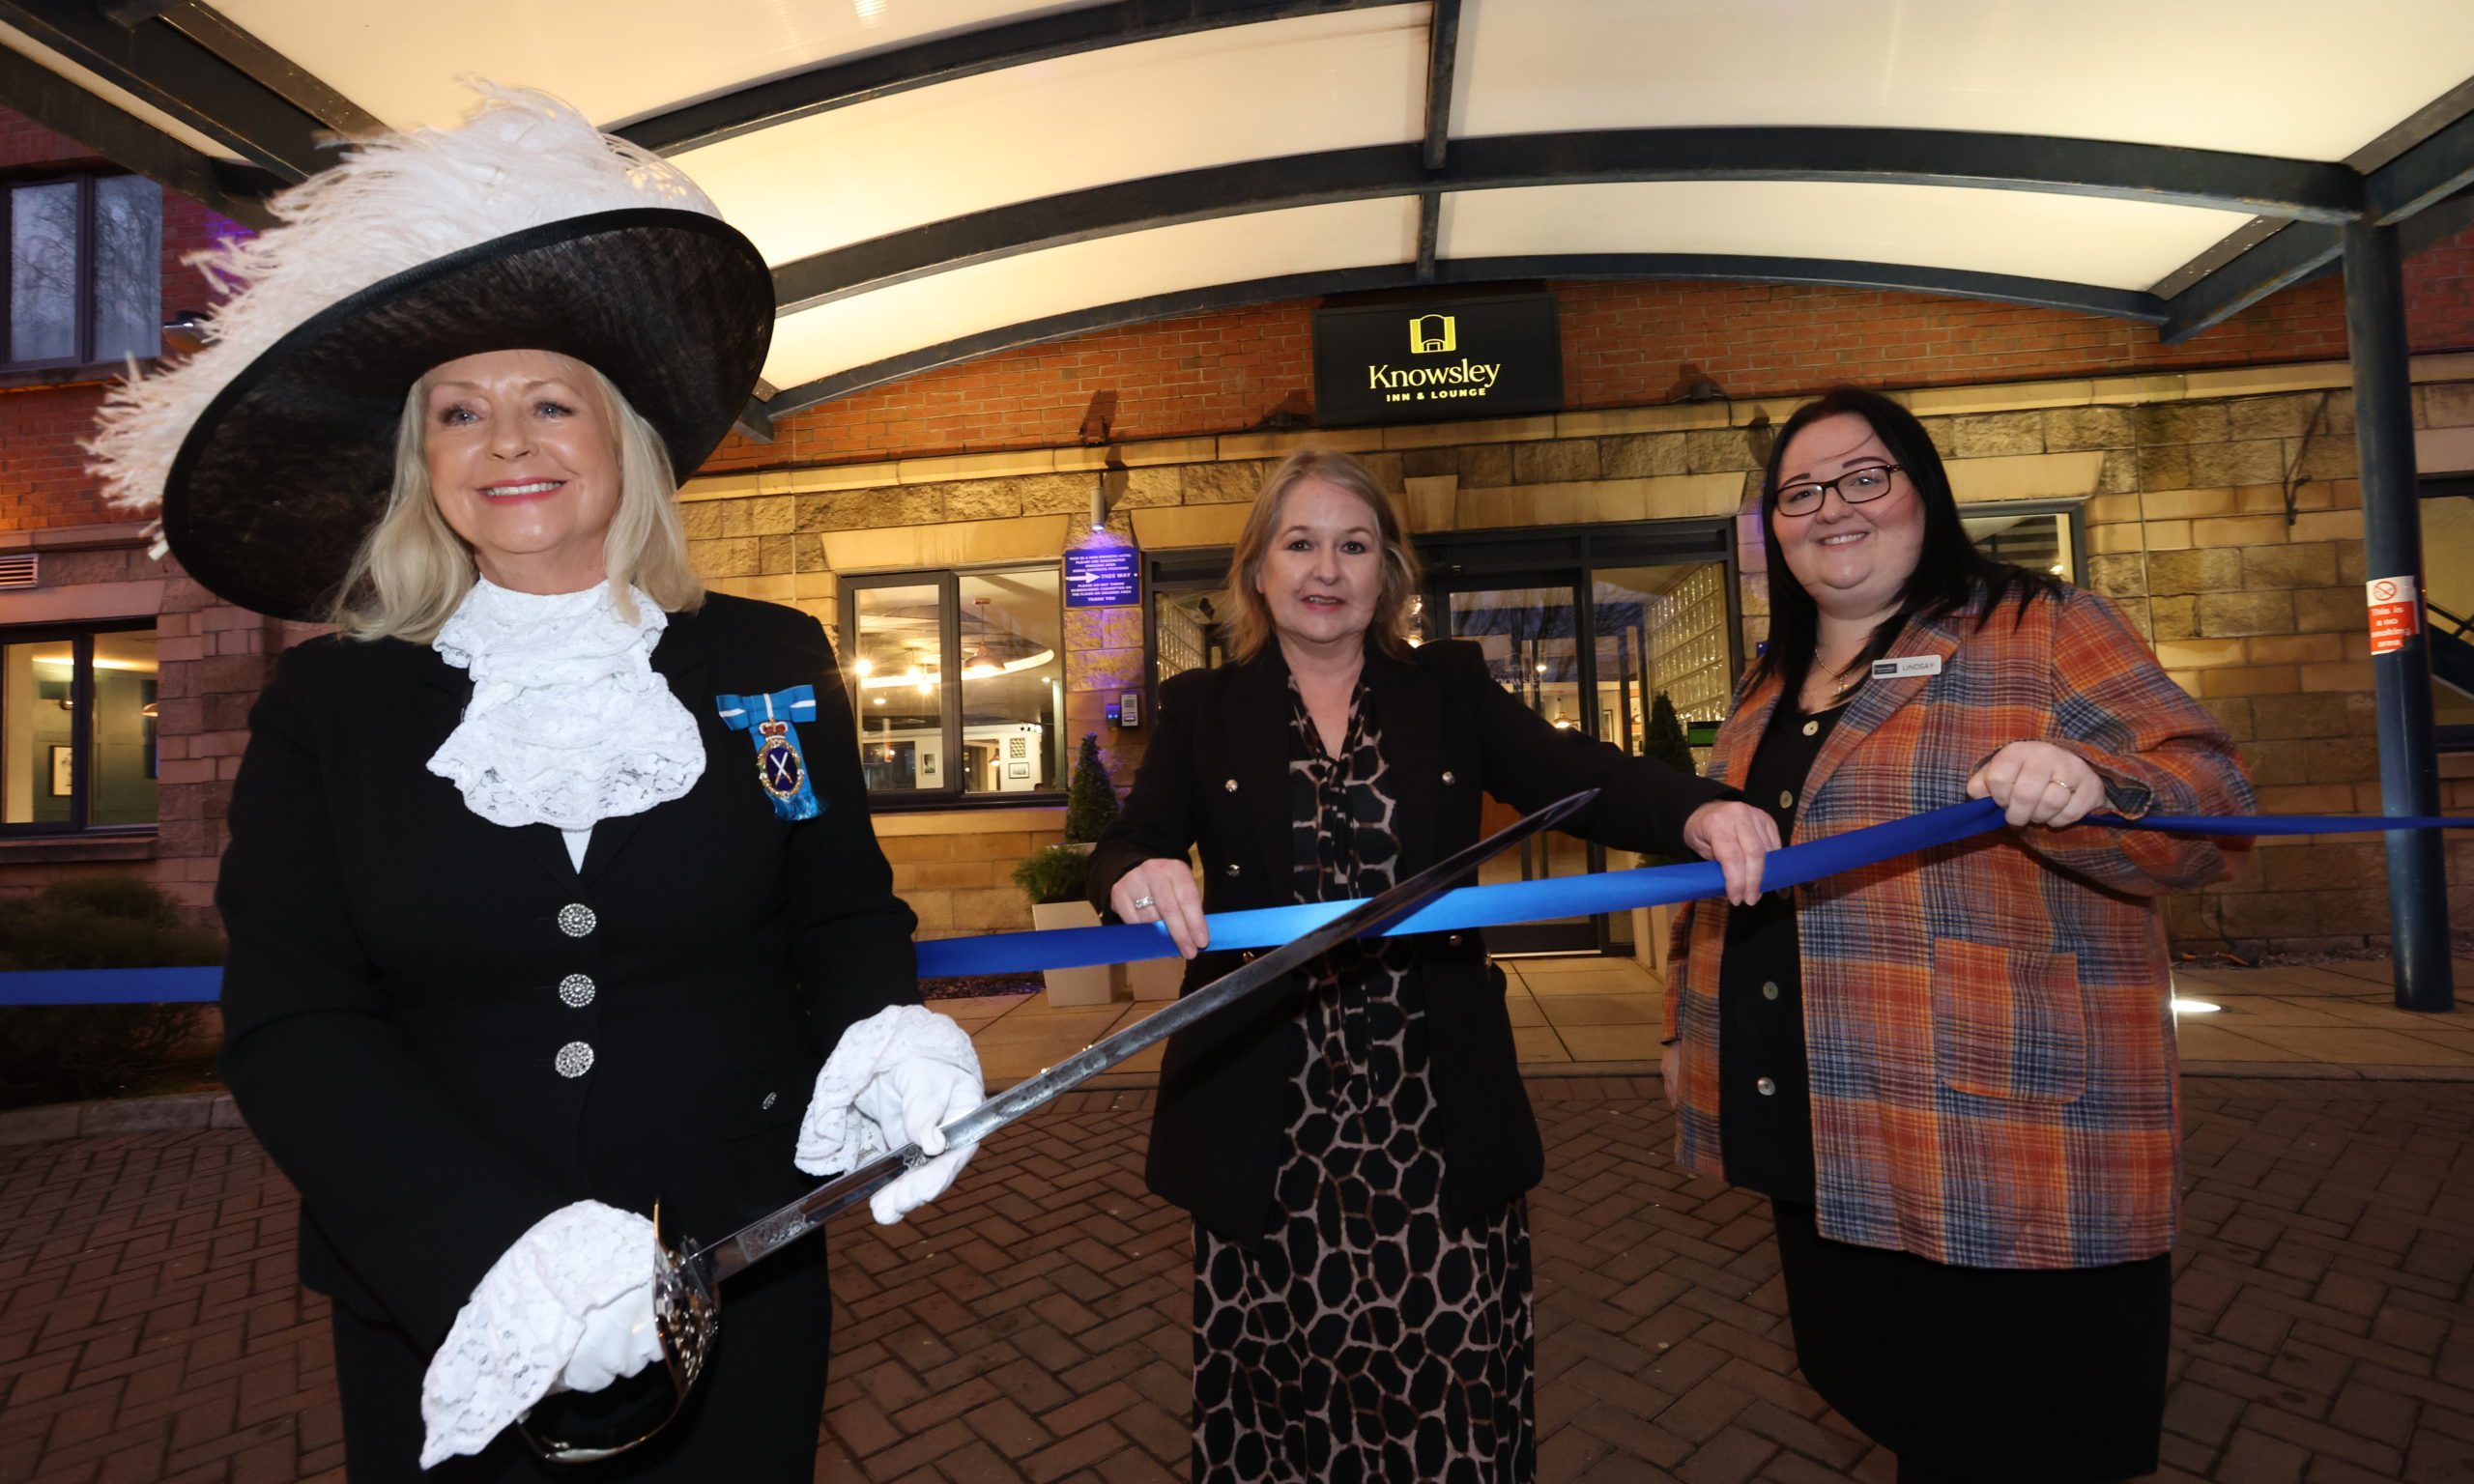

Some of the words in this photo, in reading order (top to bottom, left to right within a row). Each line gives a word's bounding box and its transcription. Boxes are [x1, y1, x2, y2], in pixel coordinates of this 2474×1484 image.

[1368, 358, 1501, 388] Knowsley
[1386, 393, 1410, 402] INN
[1417, 392, 1424, 400] &
[1431, 388, 1486, 399] LOUNGE
[2371, 607, 2391, 616] This
[1902, 663, 1934, 671] LINDSAY
